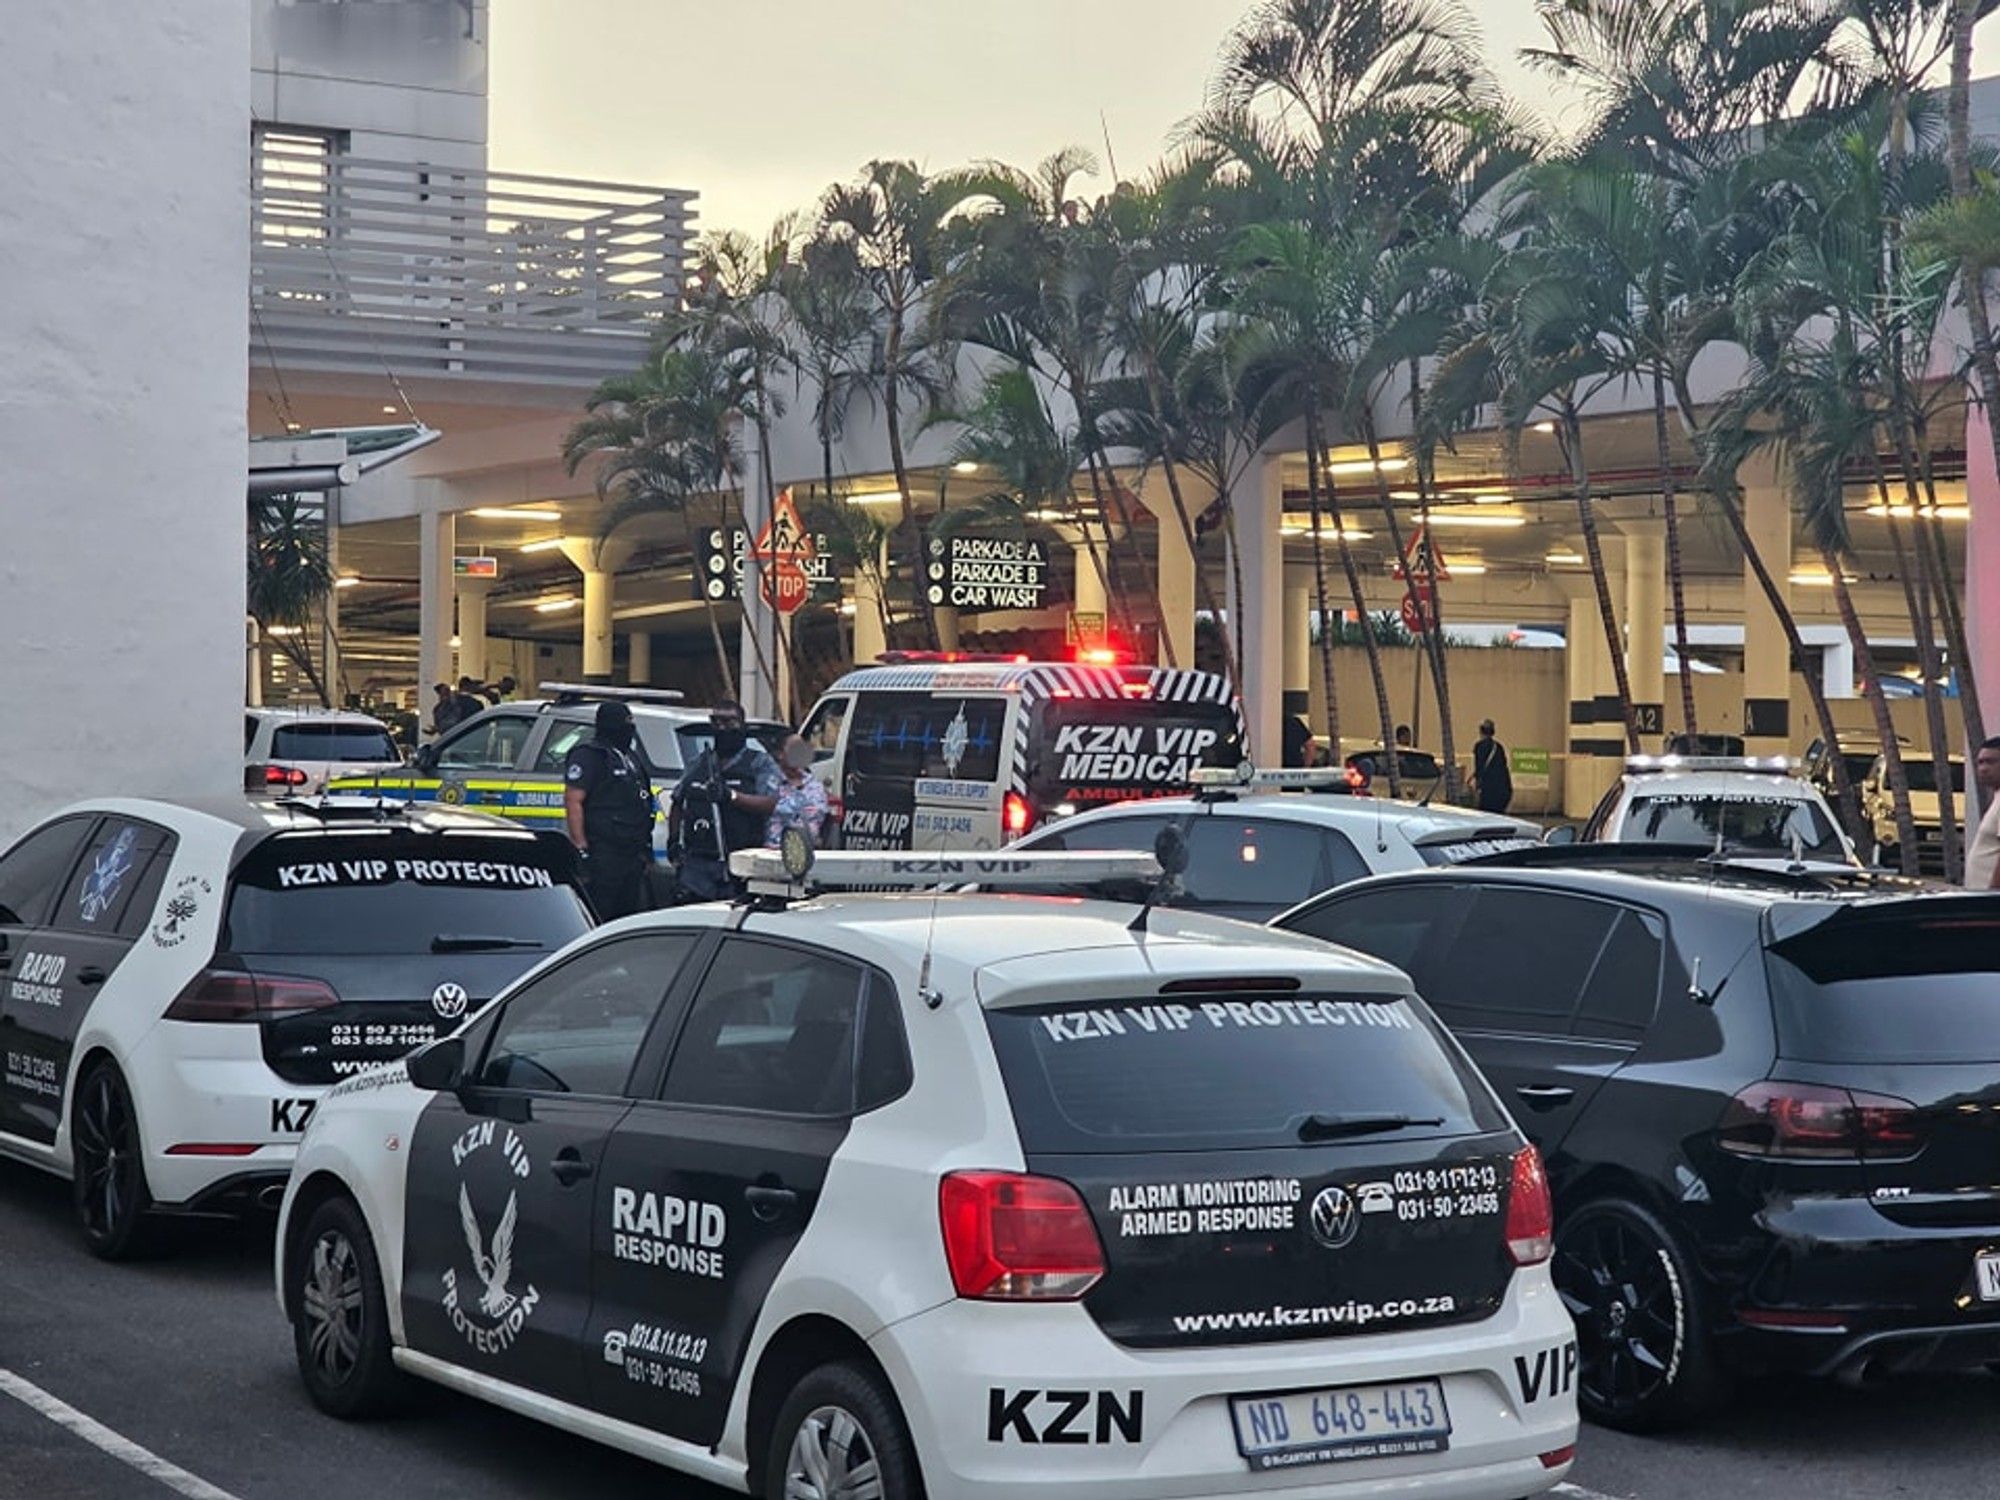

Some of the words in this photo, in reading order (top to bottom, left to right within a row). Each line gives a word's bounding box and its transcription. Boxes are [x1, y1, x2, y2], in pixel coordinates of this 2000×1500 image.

[952, 539, 1024, 560] PARKADE
[1027, 542, 1041, 561] A
[952, 562, 1024, 583] PARKADE
[1027, 566, 1038, 584] B
[950, 585, 988, 606] CAR
[991, 587, 1038, 608] WASH
[1054, 725, 1143, 754] KZN
[1156, 727, 1218, 756] VIP
[842, 809, 879, 833] KZN
[880, 812, 910, 836] VIP
[278, 862, 339, 886] KZN
[341, 860, 387, 880] VIP
[393, 860, 553, 888] PROTECTION
[892, 861, 964, 873] KZN
[975, 861, 1032, 873] VIP
[17, 951, 66, 985] RAPID
[11, 981, 63, 1008] RESPONSE
[331, 1024, 361, 1035] 031
[1041, 1009, 1126, 1043] KZN
[1124, 1003, 1194, 1033] VIP
[1199, 1000, 1412, 1031] PROTECTION
[452, 1120, 495, 1167] KZN
[503, 1128, 531, 1179] VIP
[1109, 1184, 1179, 1212] ALARM
[1183, 1179, 1301, 1207] MONITORING
[612, 1186, 726, 1248] RAPID
[1120, 1210, 1192, 1238] ARMED
[1197, 1206, 1294, 1233] RESPONSE
[614, 1232, 724, 1279] RESPONSE
[441, 1267, 541, 1355] PROTECTION
[1173, 1295, 1455, 1333] www.kznvip.co.za
[1513, 1340, 1577, 1404] VIP
[987, 1387, 1144, 1444] KZN
[1248, 1402, 1290, 1444] ND
[1311, 1386, 1435, 1437] 648-443
